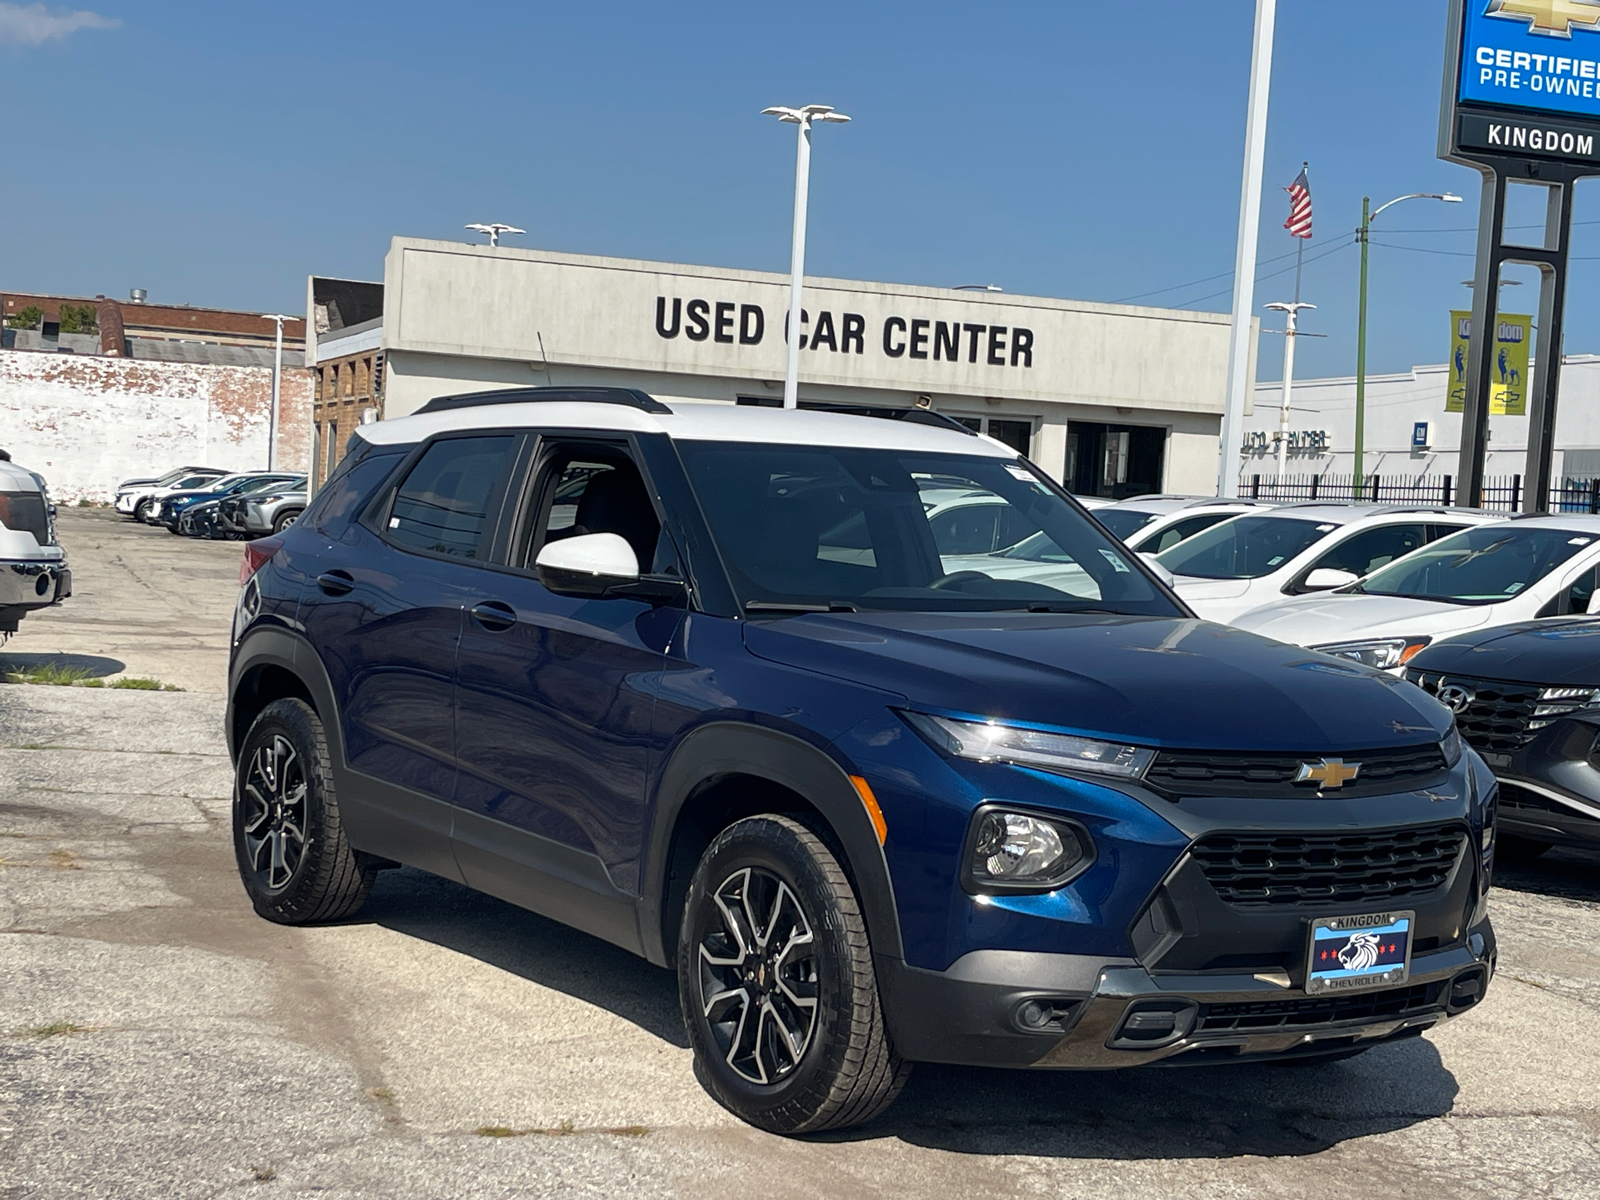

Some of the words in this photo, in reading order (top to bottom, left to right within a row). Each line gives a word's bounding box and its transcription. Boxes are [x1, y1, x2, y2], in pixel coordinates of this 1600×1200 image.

[1476, 46, 1600, 80] CERTIFIE
[1488, 124, 1593, 155] KINGDOM
[655, 296, 764, 345] USED
[785, 307, 866, 355] CAR
[883, 316, 1034, 368] CENTER
[1337, 914, 1391, 928] KINGDOM
[1329, 975, 1384, 989] CHEVROLET
